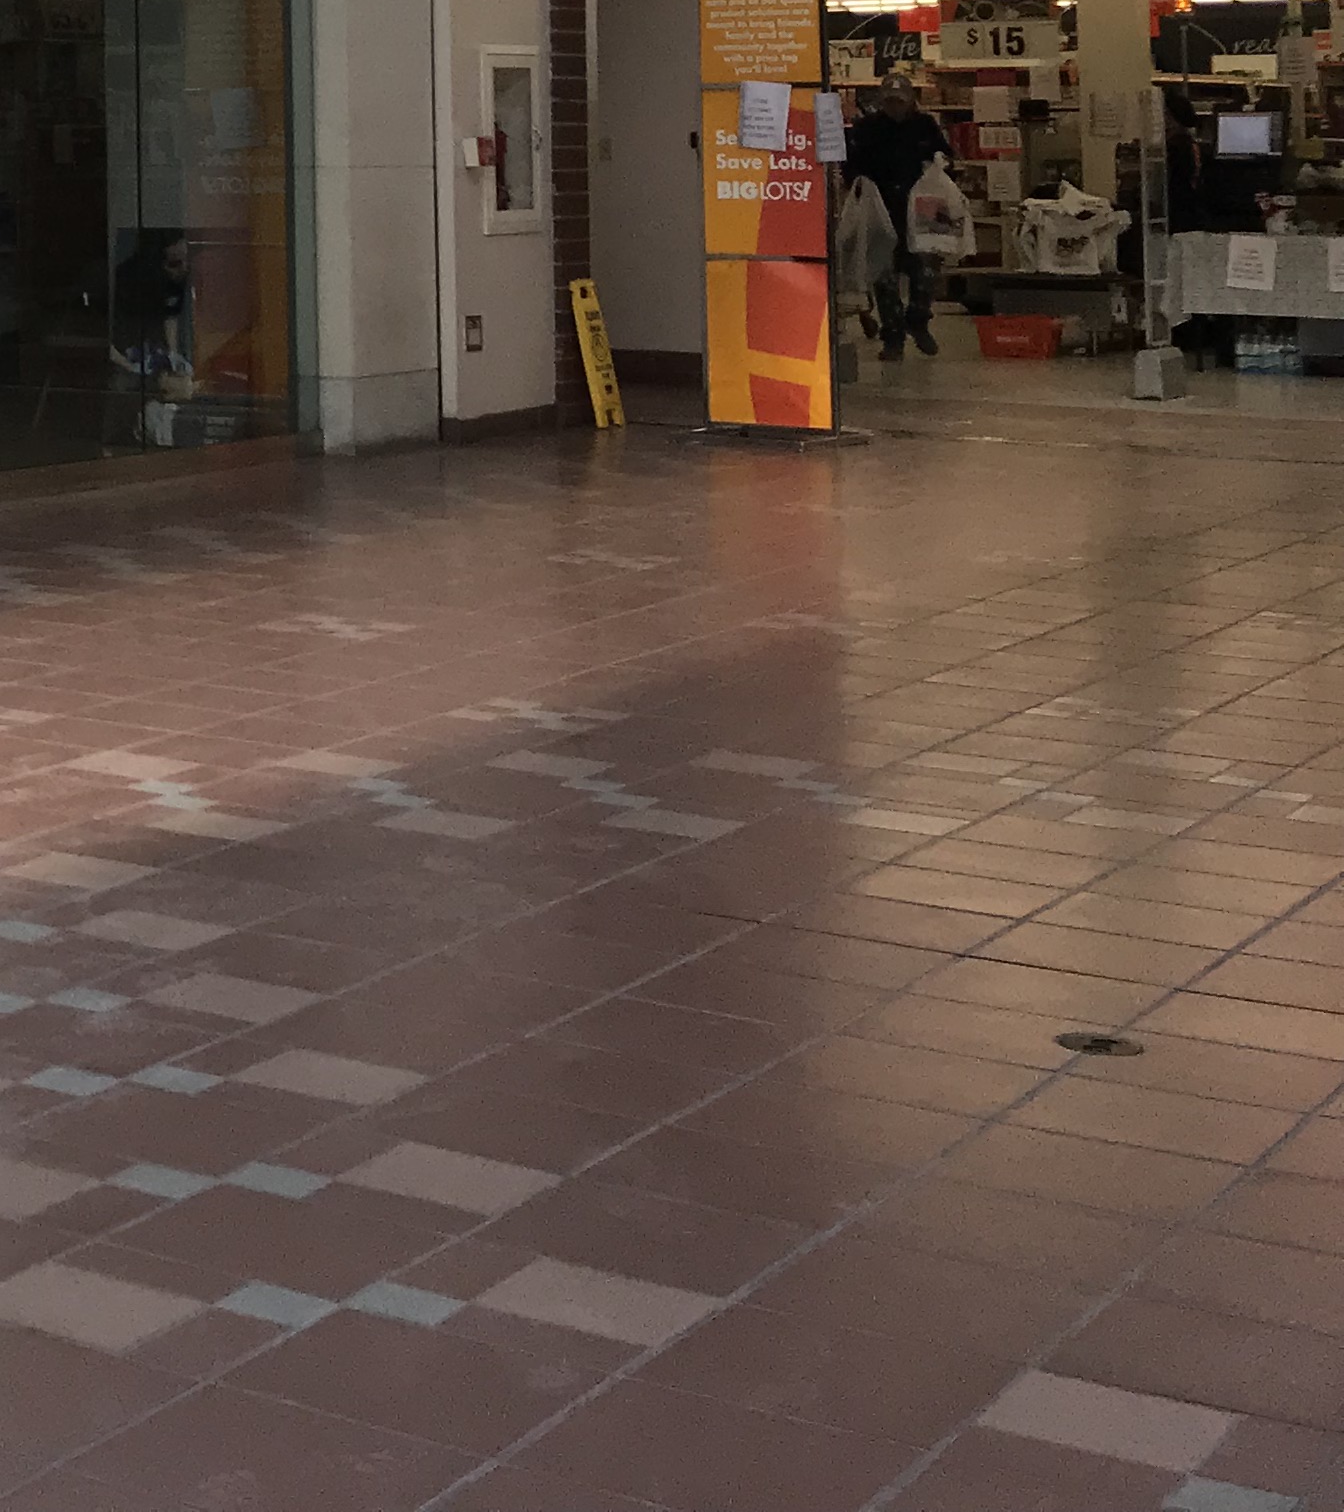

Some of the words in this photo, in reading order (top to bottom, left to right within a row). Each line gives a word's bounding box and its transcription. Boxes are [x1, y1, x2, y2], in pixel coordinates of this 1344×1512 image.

[989, 26, 1025, 57] 15
[787, 130, 812, 151] ig.
[715, 153, 762, 169] Save
[769, 154, 813, 171] Lots.
